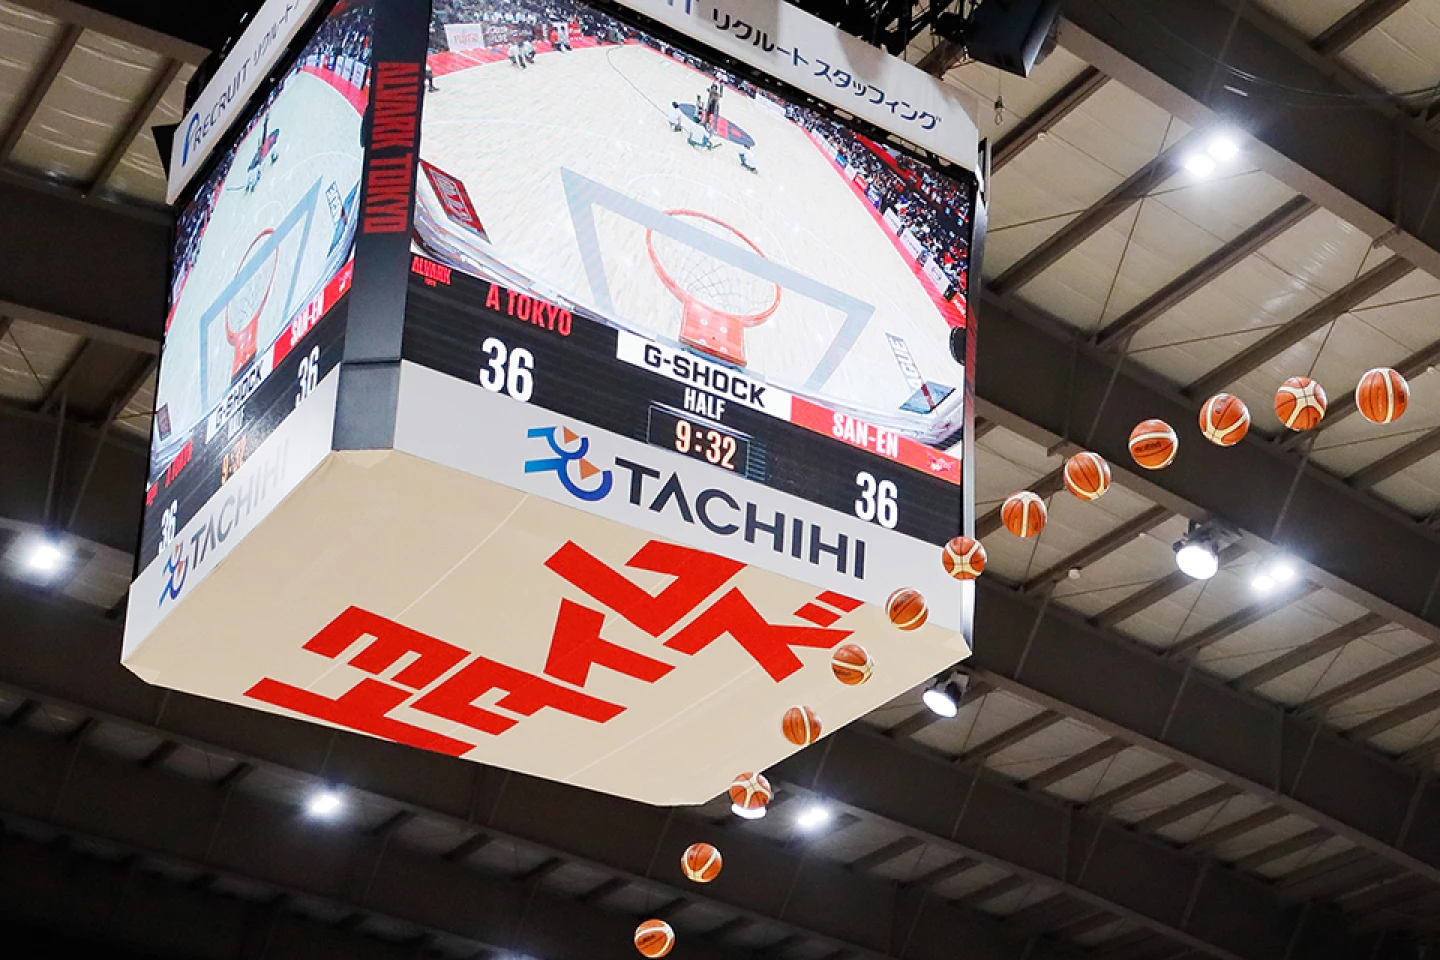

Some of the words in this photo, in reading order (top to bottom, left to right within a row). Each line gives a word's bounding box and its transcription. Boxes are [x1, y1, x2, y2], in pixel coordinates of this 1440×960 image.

[712, 9, 810, 67] リクルート
[813, 60, 943, 130] スタッフィング
[189, 58, 249, 152] RECRUIT
[371, 61, 420, 150] ALVARK
[363, 152, 413, 234] TOKYO
[485, 283, 501, 311] A
[506, 289, 574, 337] TOKYO
[479, 336, 536, 403] 36
[643, 343, 766, 408] G-SHOCK
[683, 386, 726, 421] HALF
[831, 412, 899, 459] SAN-EN
[673, 418, 738, 471] 9:32
[189, 438, 290, 571] TACHIHI
[615, 456, 867, 581] TACHIHI
[854, 470, 898, 530] 36
